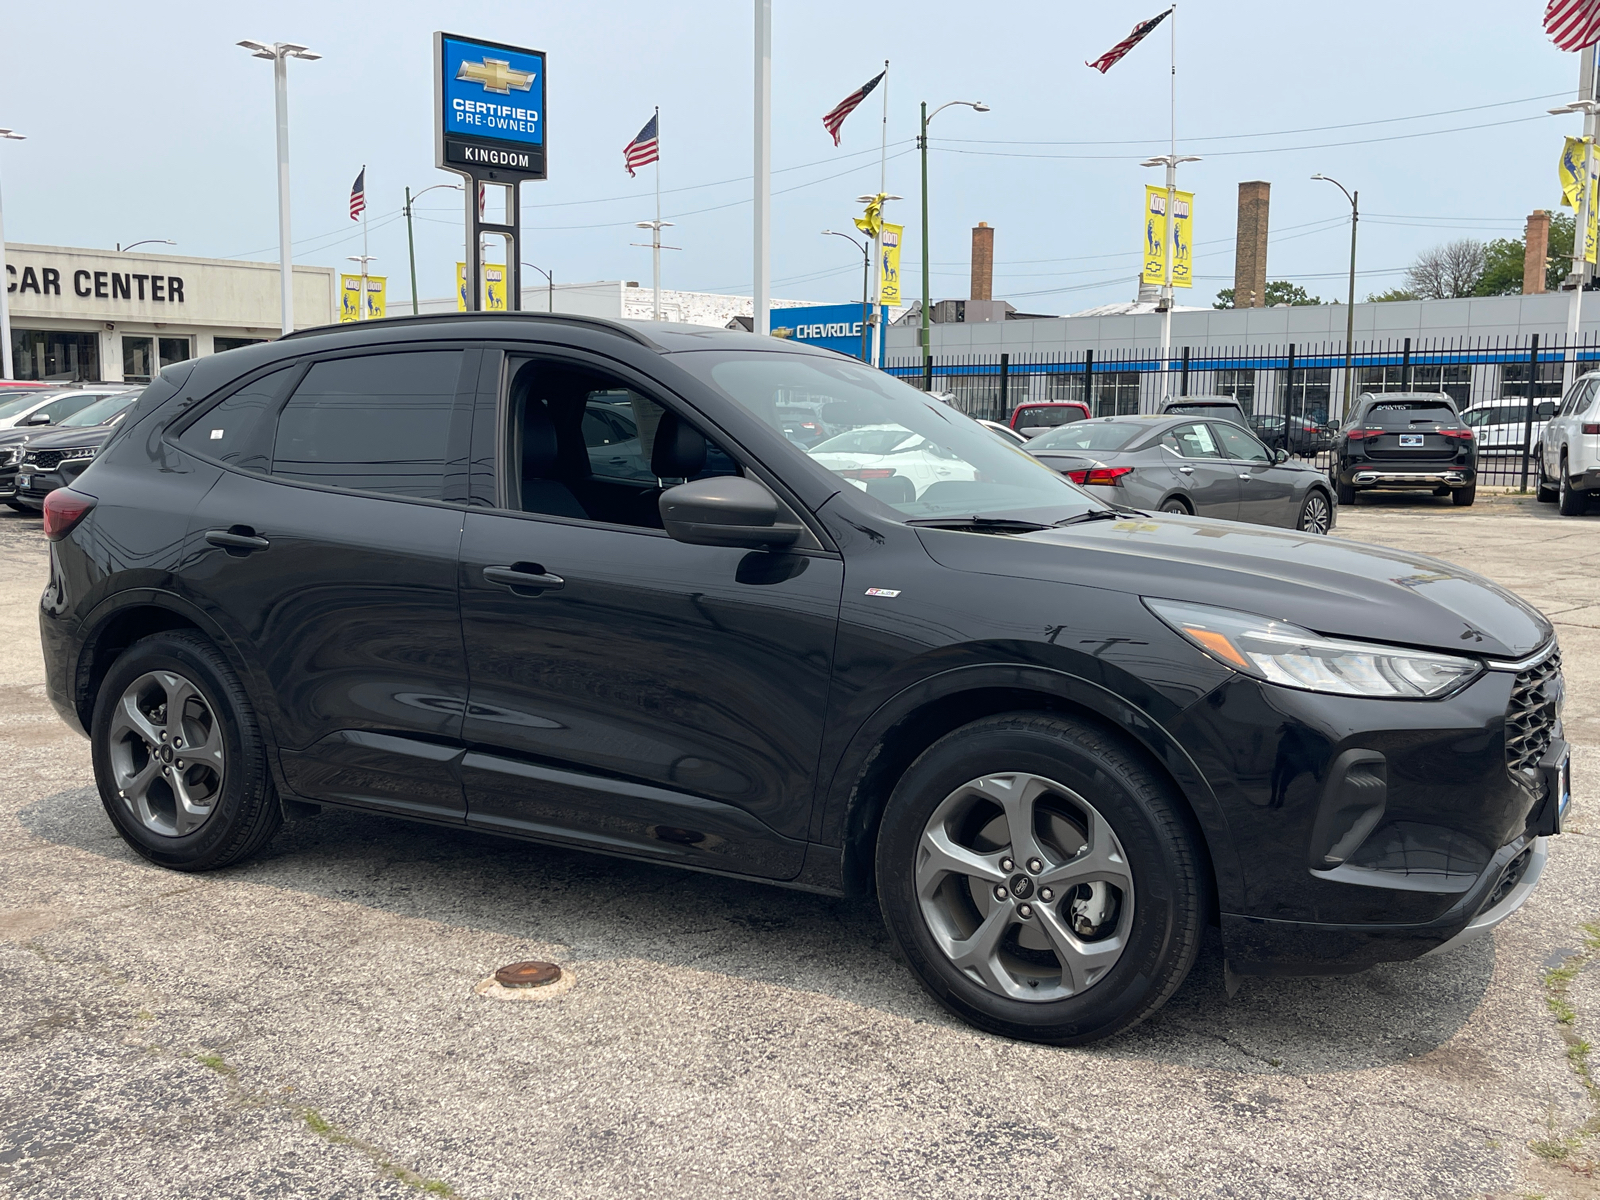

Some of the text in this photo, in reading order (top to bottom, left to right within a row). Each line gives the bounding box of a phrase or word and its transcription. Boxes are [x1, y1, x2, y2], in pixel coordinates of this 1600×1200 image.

[452, 98, 539, 122] CERTIFIED
[456, 112, 535, 133] PRE-OWNED
[464, 146, 529, 168] KINGDOM
[1150, 193, 1165, 216] King
[882, 229, 898, 248] dom
[5, 264, 185, 303] CAR CENTER
[346, 278, 382, 292] King dom
[486, 268, 502, 282] dom
